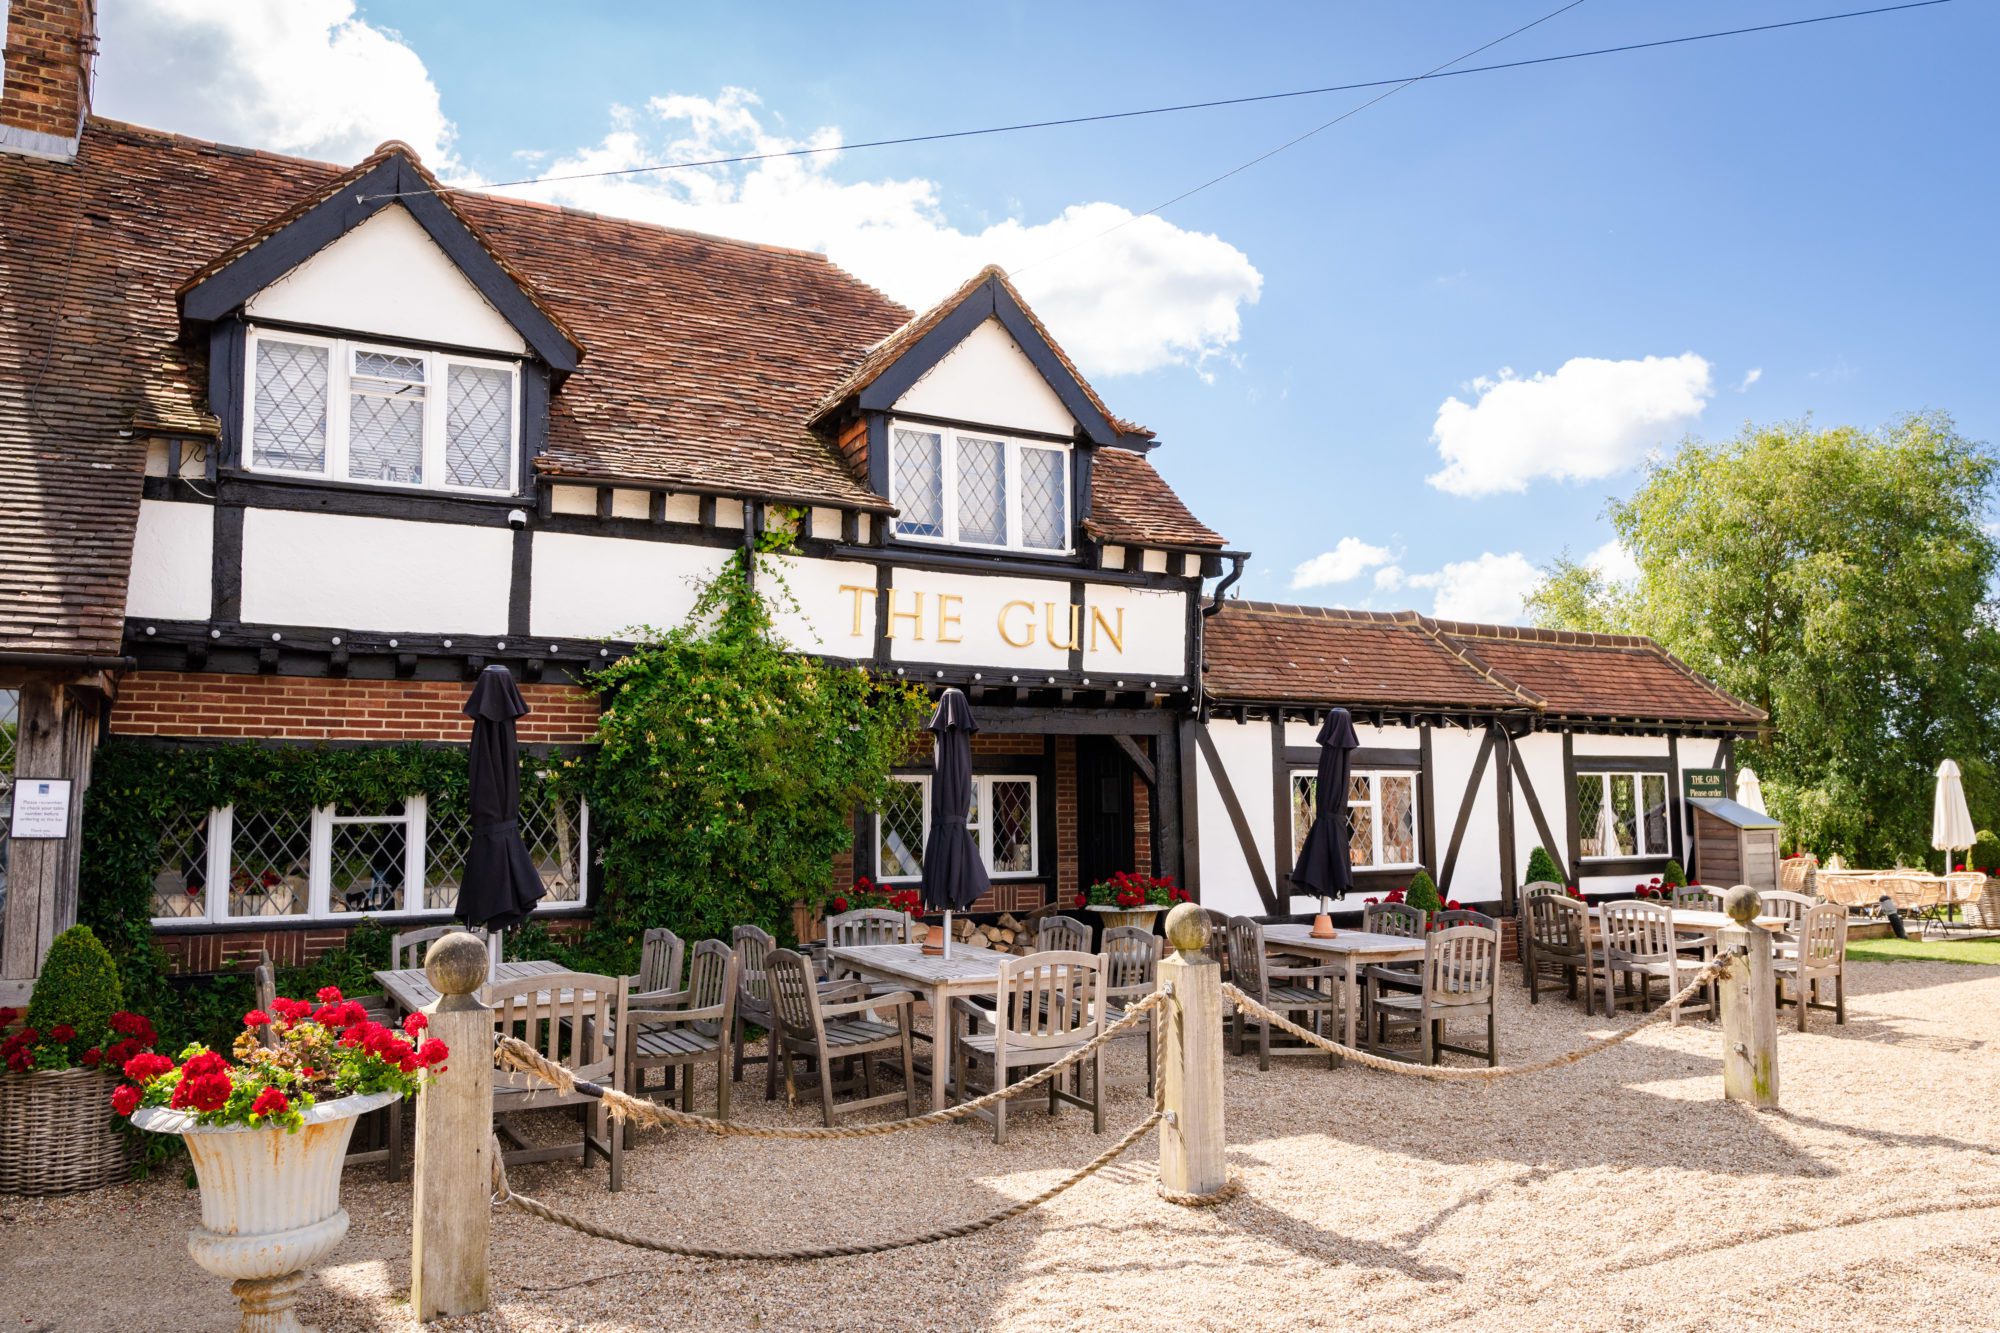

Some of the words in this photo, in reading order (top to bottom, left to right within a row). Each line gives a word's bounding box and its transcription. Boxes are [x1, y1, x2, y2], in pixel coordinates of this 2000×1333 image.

[838, 584, 963, 643] THE
[997, 600, 1126, 655] GUN
[1691, 775, 1704, 785] THE
[1705, 775, 1720, 785] GUN
[1690, 789, 1707, 797] Please
[1708, 789, 1722, 797] order
